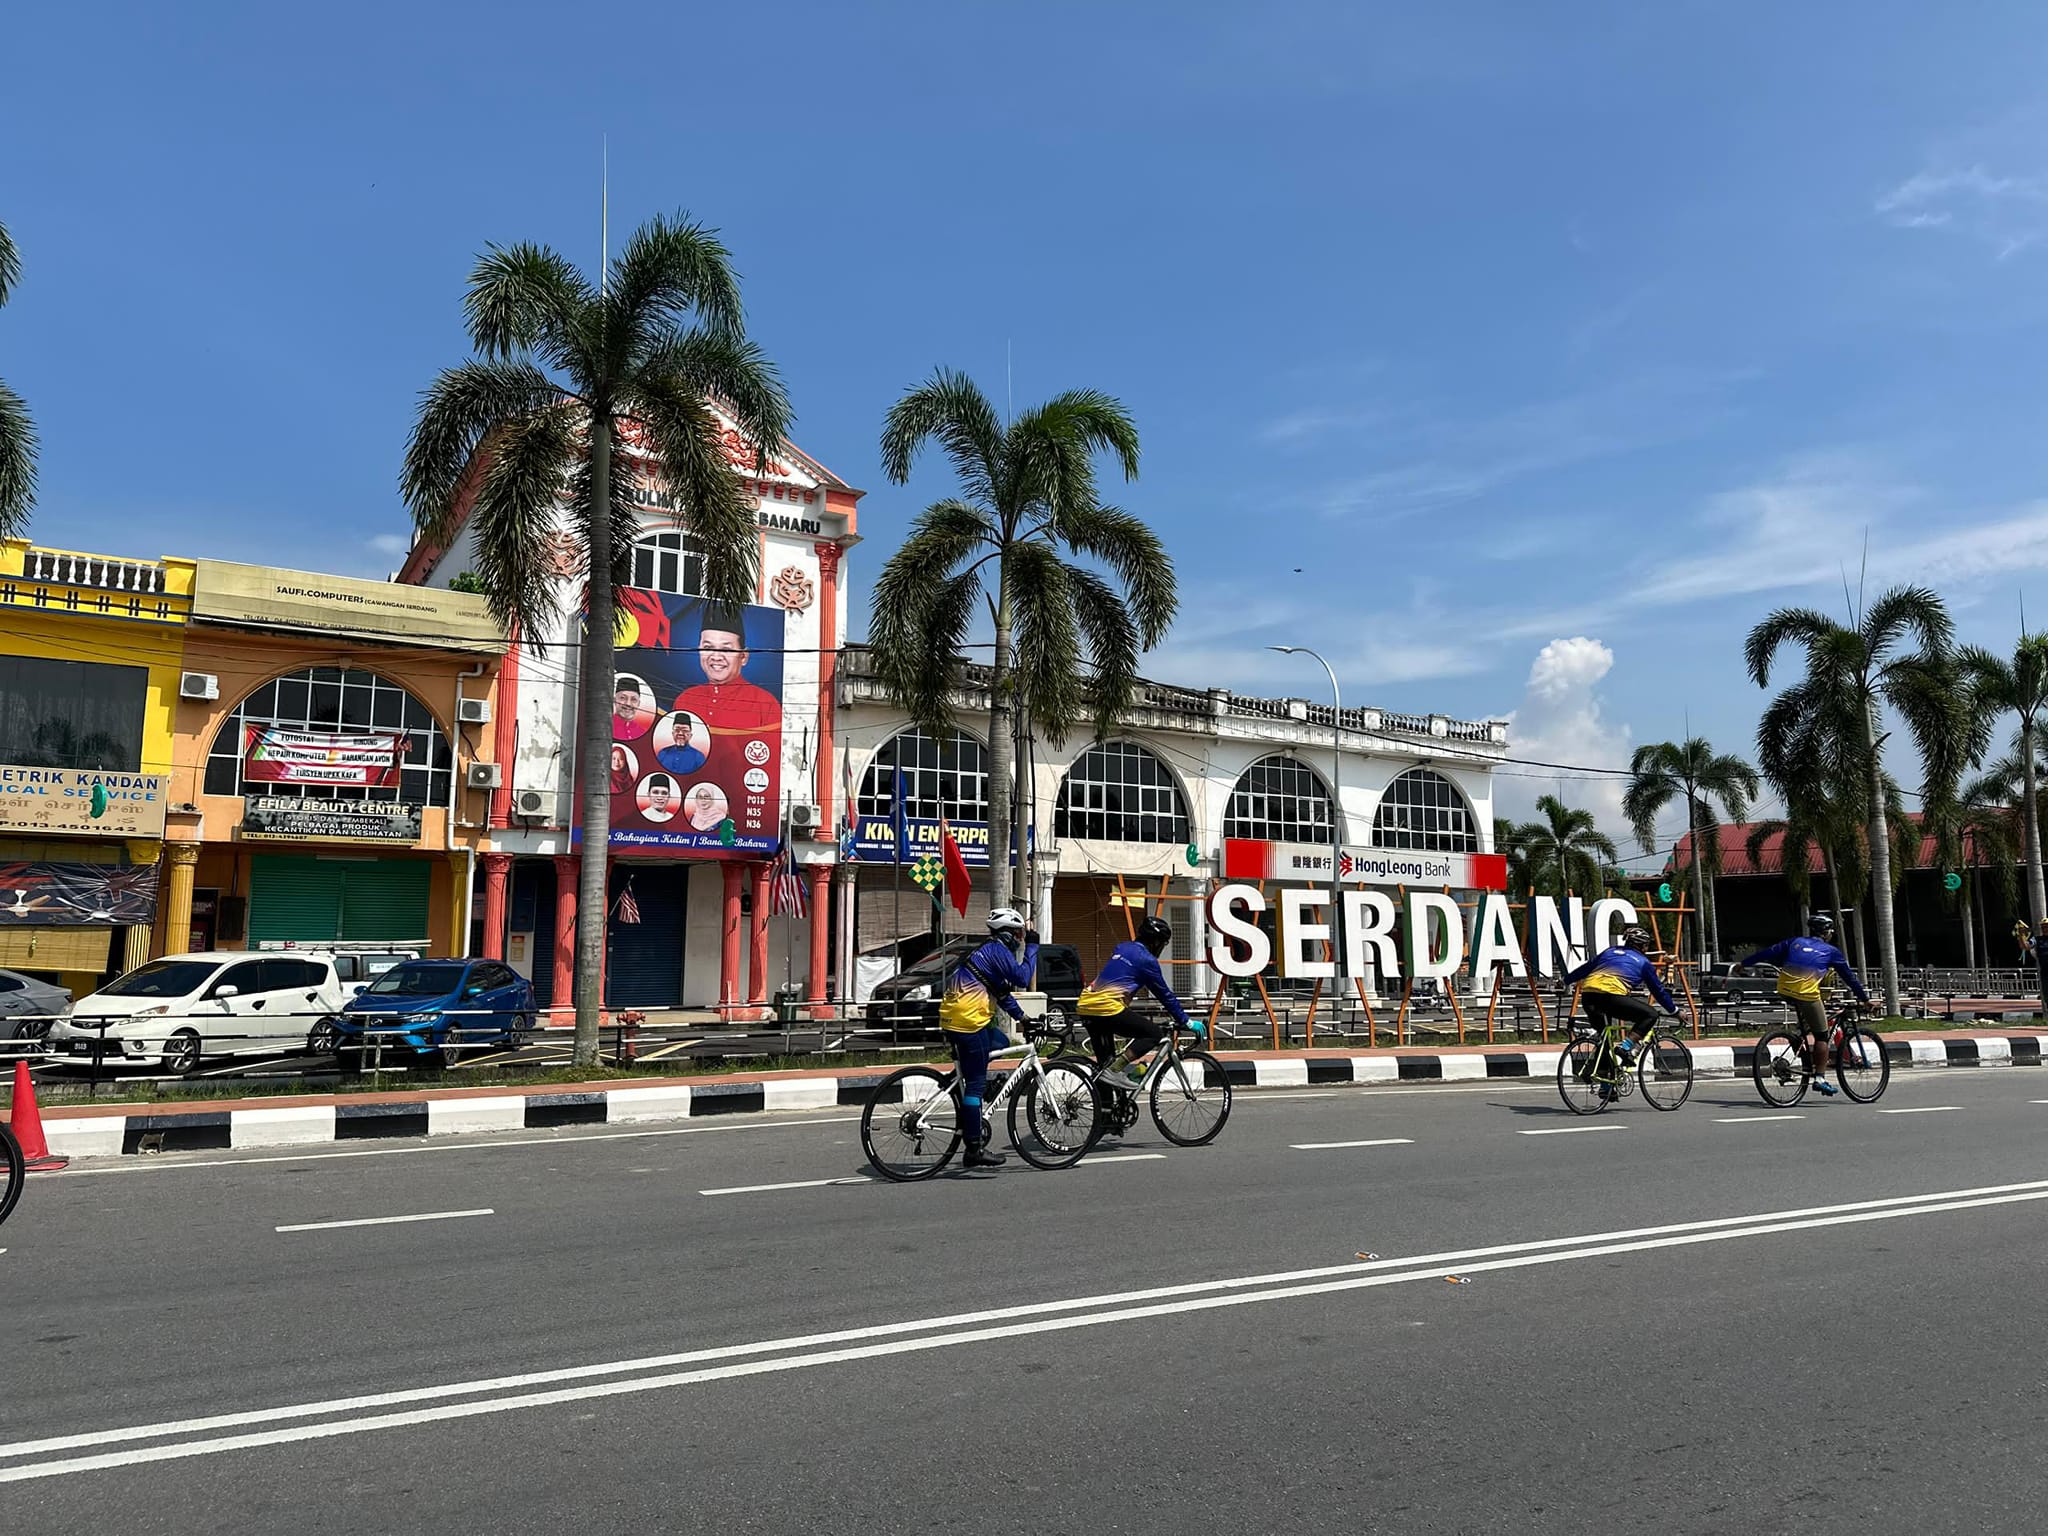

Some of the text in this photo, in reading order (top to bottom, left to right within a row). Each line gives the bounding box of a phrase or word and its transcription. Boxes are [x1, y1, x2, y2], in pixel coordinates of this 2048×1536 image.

[758, 512, 820, 534] BAHARU
[77, 773, 158, 790] KANDAN
[64, 788, 156, 801] SEVICE
[747, 795, 766, 805] P018
[258, 799, 409, 815] EFILA BEAUTY CENTRE
[746, 807, 761, 817] N35
[265, 826, 326, 834] KECANTIKAN
[342, 823, 380, 831] PRODUK
[746, 819, 761, 829] N36
[610, 831, 659, 845] Bahagian
[661, 834, 690, 845] Kulim
[734, 838, 768, 848] Baharu
[1292, 856, 1332, 869] 豐隆銀行
[1425, 861, 1450, 876] Bank
